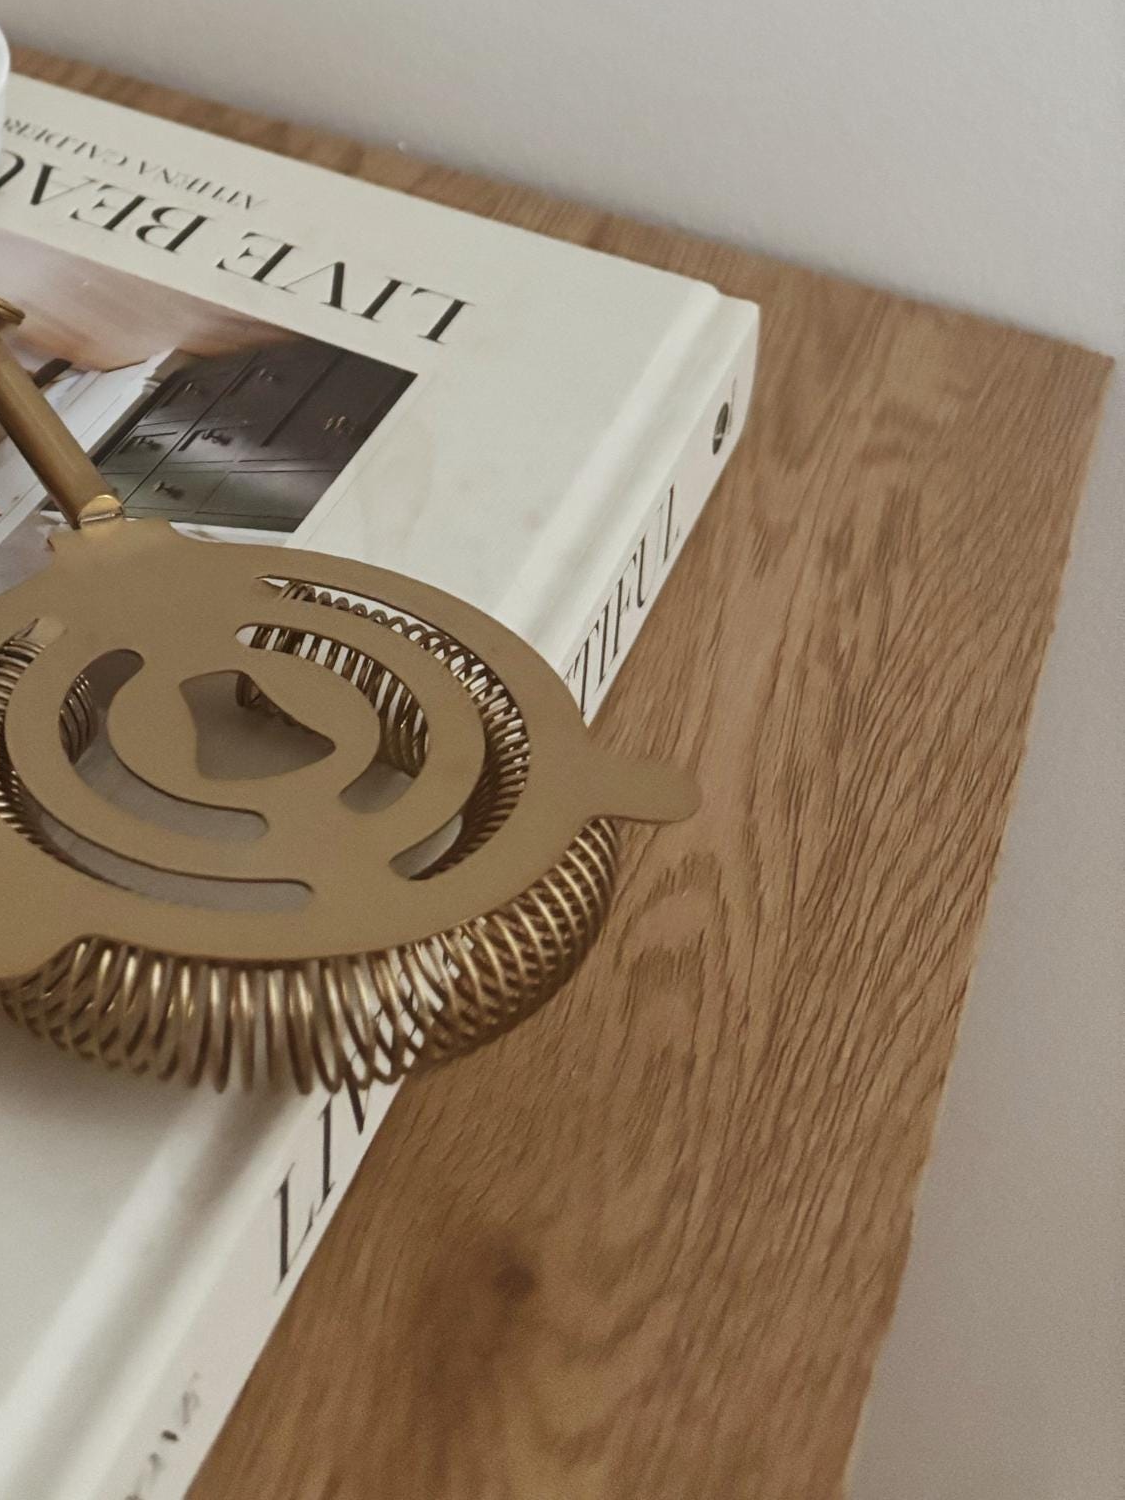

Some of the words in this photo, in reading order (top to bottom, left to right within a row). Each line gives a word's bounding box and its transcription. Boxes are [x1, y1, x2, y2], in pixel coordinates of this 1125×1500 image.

[3, 116, 128, 168] CALDER
[136, 158, 277, 211] ATHENA
[215, 230, 476, 345] LIVE
